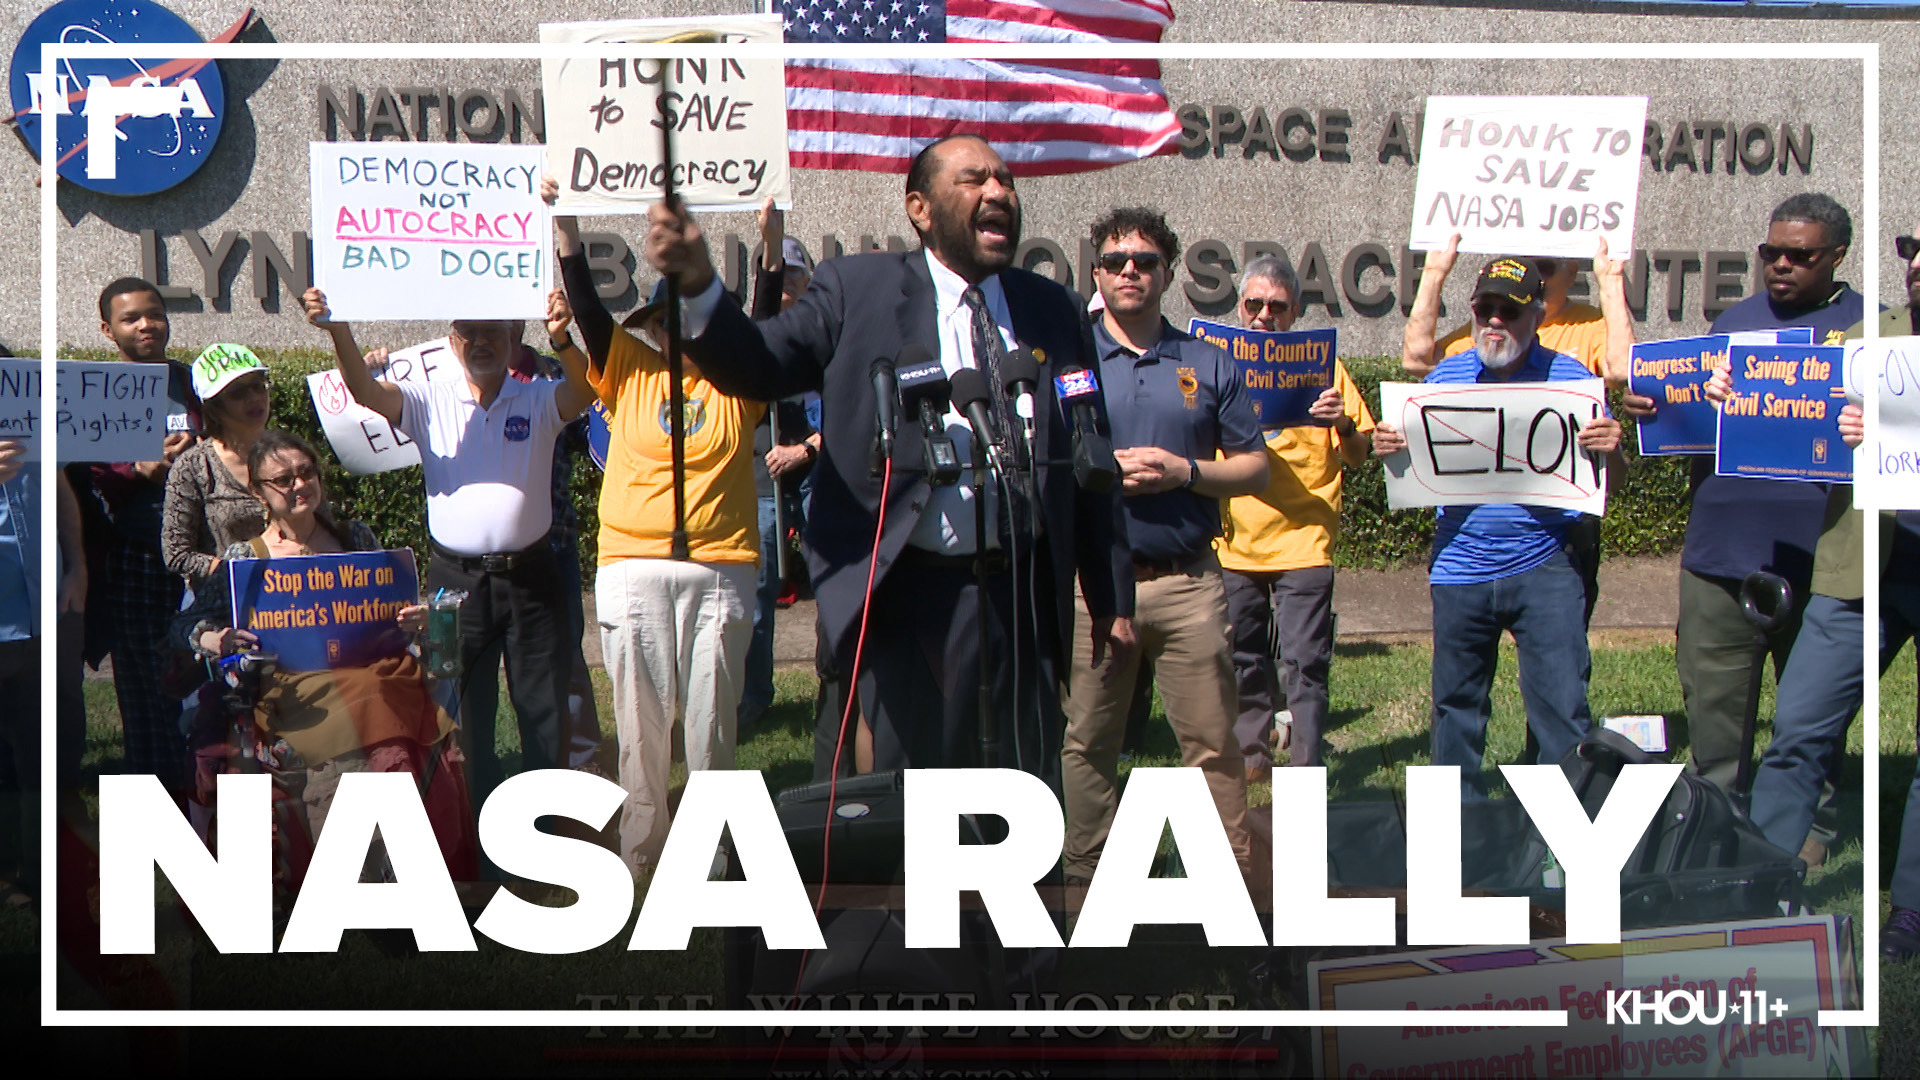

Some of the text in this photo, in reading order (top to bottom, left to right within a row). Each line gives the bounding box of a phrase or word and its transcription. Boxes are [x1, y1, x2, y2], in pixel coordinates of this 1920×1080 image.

[25, 73, 215, 118] NA
[590, 91, 753, 133] to SAVE
[1175, 103, 1350, 153] SPACE
[1439, 117, 1632, 156] HONK TO
[339, 157, 536, 194] DEMOCRACY
[570, 147, 767, 196] Democracy
[1475, 154, 1596, 192] SAVE
[419, 192, 471, 209] NOT
[1425, 191, 1624, 232] NASA JOBS
[336, 206, 533, 240] AUTOCRACY
[342, 244, 541, 288] BAD DOGE!
[1232, 335, 1260, 362] the
[1264, 338, 1331, 366] Country
[81, 371, 163, 400] FIGHT
[1064, 379, 1090, 392] 26
[1245, 367, 1331, 391] Civil Service!
[1633, 357, 1698, 381] Congress:
[1744, 355, 1831, 386] Saving the
[1665, 382, 1702, 404] Don't
[1724, 391, 1760, 416] Civil
[1763, 392, 1826, 420] Service
[56, 407, 153, 442] Rights!
[1420, 403, 1600, 489] ELON
[263, 563, 394, 597] Stop the War on
[248, 602, 329, 630] America's
[1559, 974, 1719, 1021] Fedation
[1545, 1033, 1708, 1080] Employees
[1717, 1016, 1817, 1069] (AFGE)
